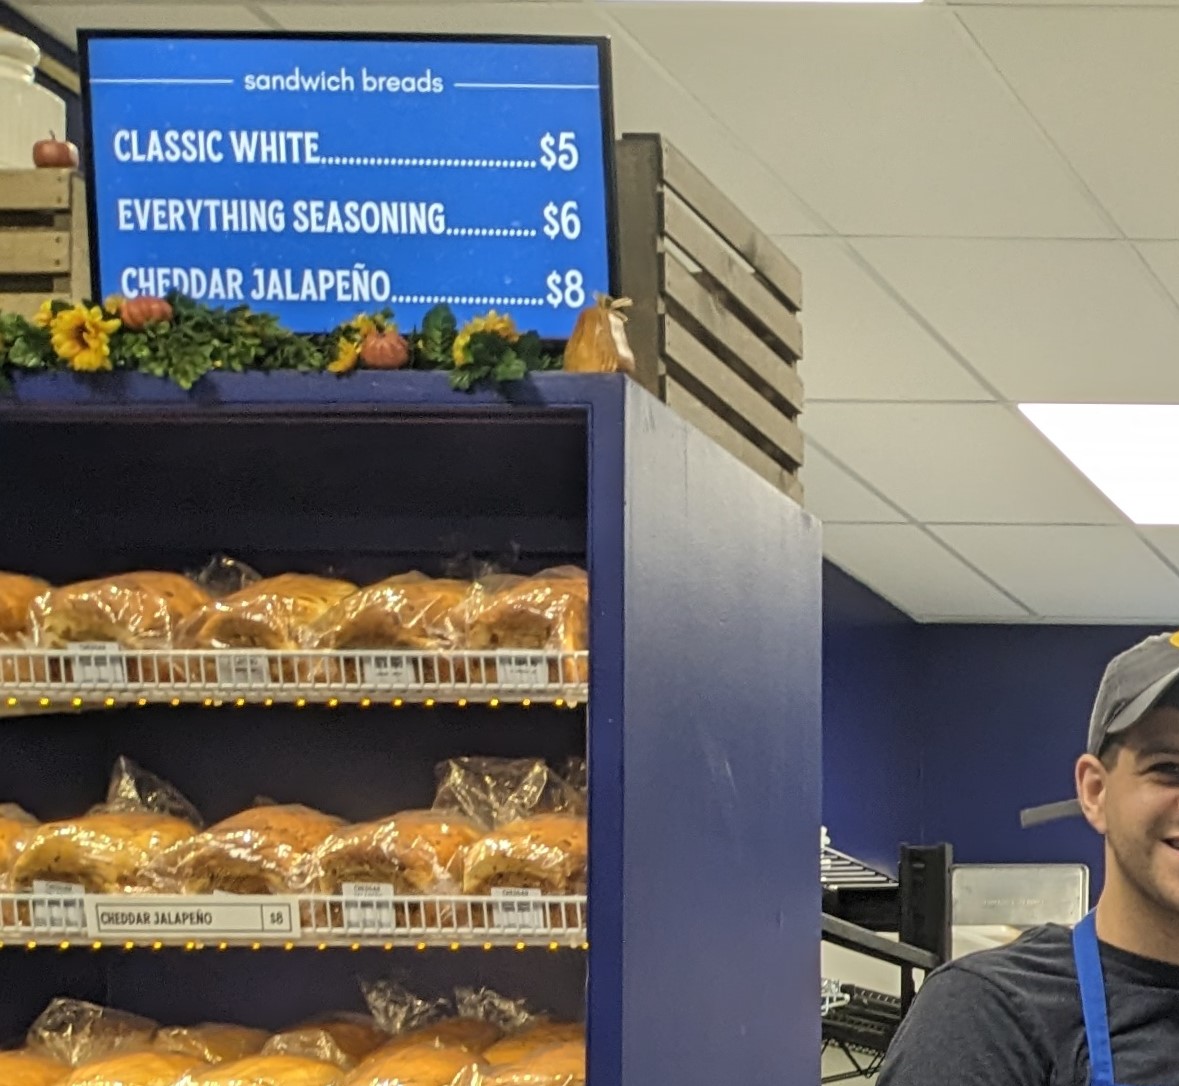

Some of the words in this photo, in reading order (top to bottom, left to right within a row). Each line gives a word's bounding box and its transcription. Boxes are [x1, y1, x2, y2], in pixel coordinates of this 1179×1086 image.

[244, 67, 355, 92] sandwich
[362, 67, 444, 93] breads
[114, 129, 222, 164] CLASSIC
[229, 130, 319, 165] WHITE
[540, 132, 579, 171] $5
[118, 199, 286, 232] EVERYTHING
[293, 200, 445, 235] SEASONING
[543, 200, 581, 240] $6
[121, 267, 244, 300] CHEDDAR
[251, 262, 391, 302] JALAPEÑO
[546, 269, 586, 309] $8
[100, 912, 150, 926] CHEDDAR
[153, 909, 213, 926] JALAPEÑO
